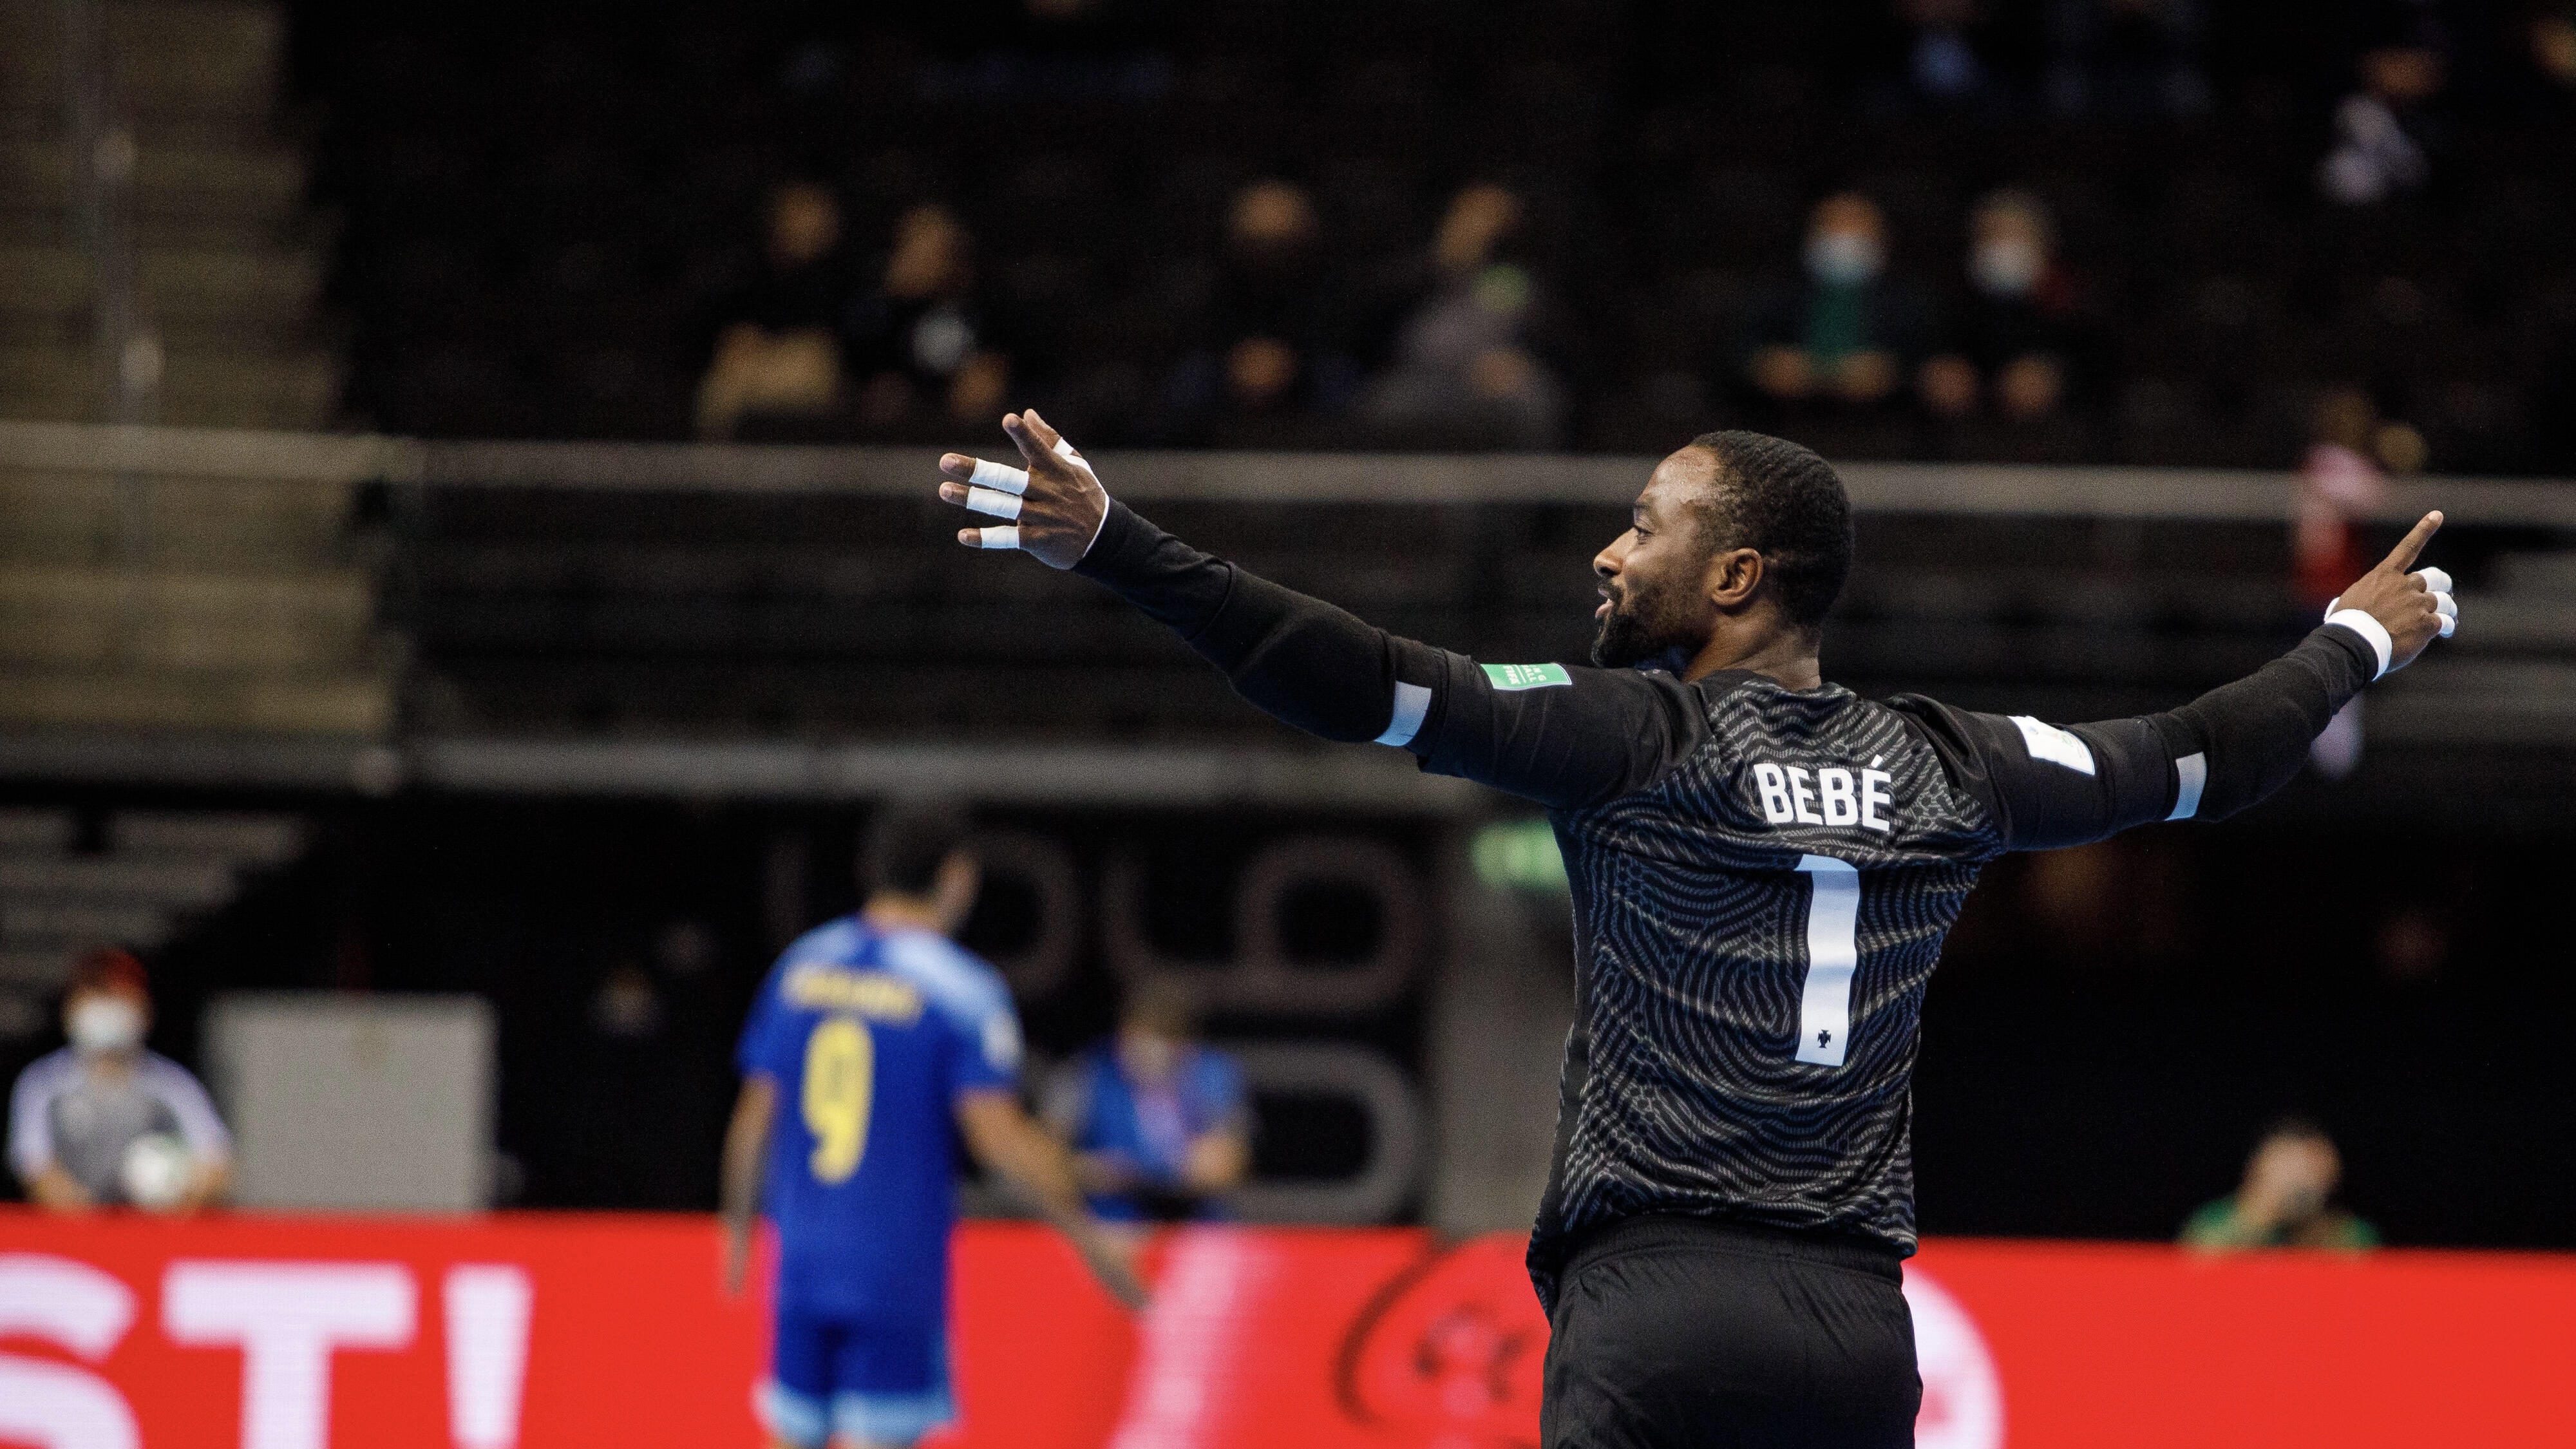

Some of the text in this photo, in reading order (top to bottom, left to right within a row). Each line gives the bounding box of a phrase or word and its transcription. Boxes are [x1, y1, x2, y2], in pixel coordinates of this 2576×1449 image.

[1754, 754, 1891, 831] BEBÉ
[1794, 854, 1860, 1066] 1
[801, 1015, 876, 1185] 9
